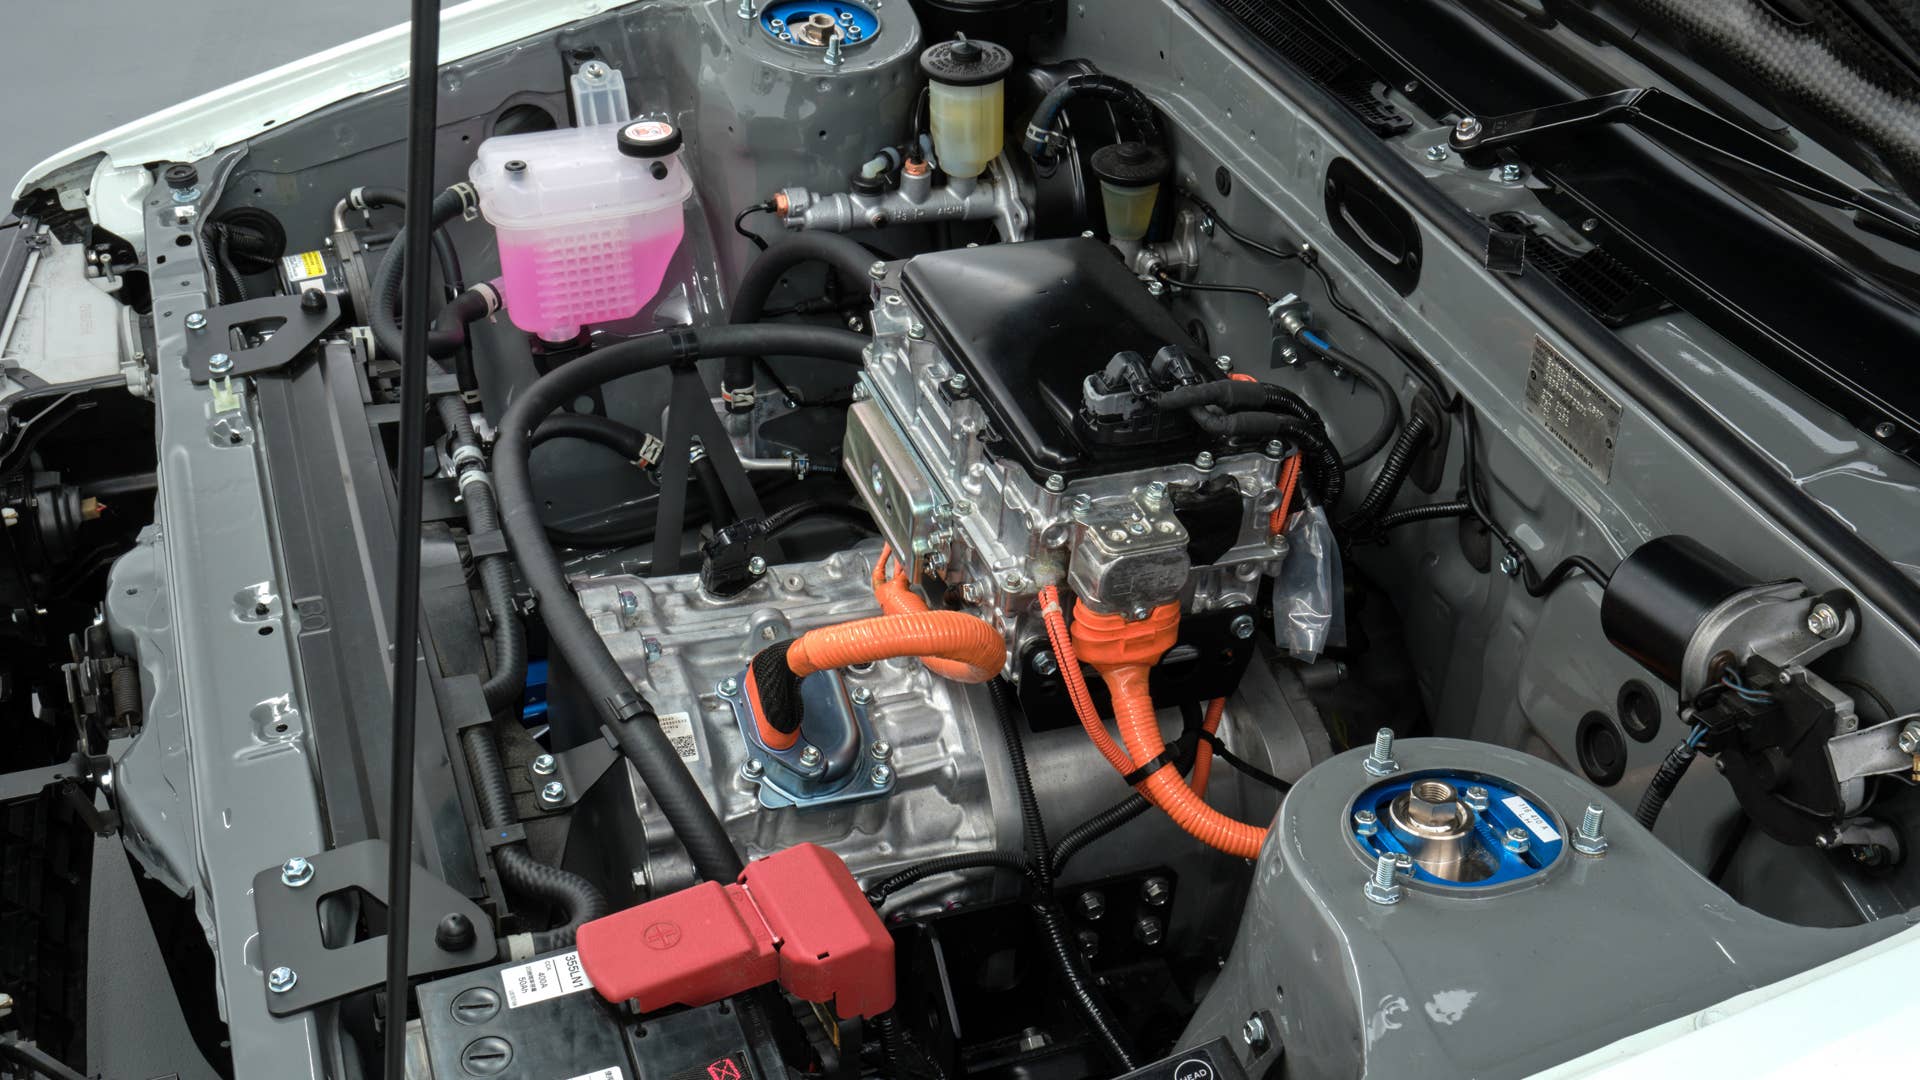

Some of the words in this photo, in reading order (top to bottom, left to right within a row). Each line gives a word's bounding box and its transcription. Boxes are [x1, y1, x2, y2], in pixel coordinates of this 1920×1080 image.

[538, 972, 548, 989] 400A
[566, 955, 584, 988] 355LN1
[518, 976, 529, 994] 50Ah
